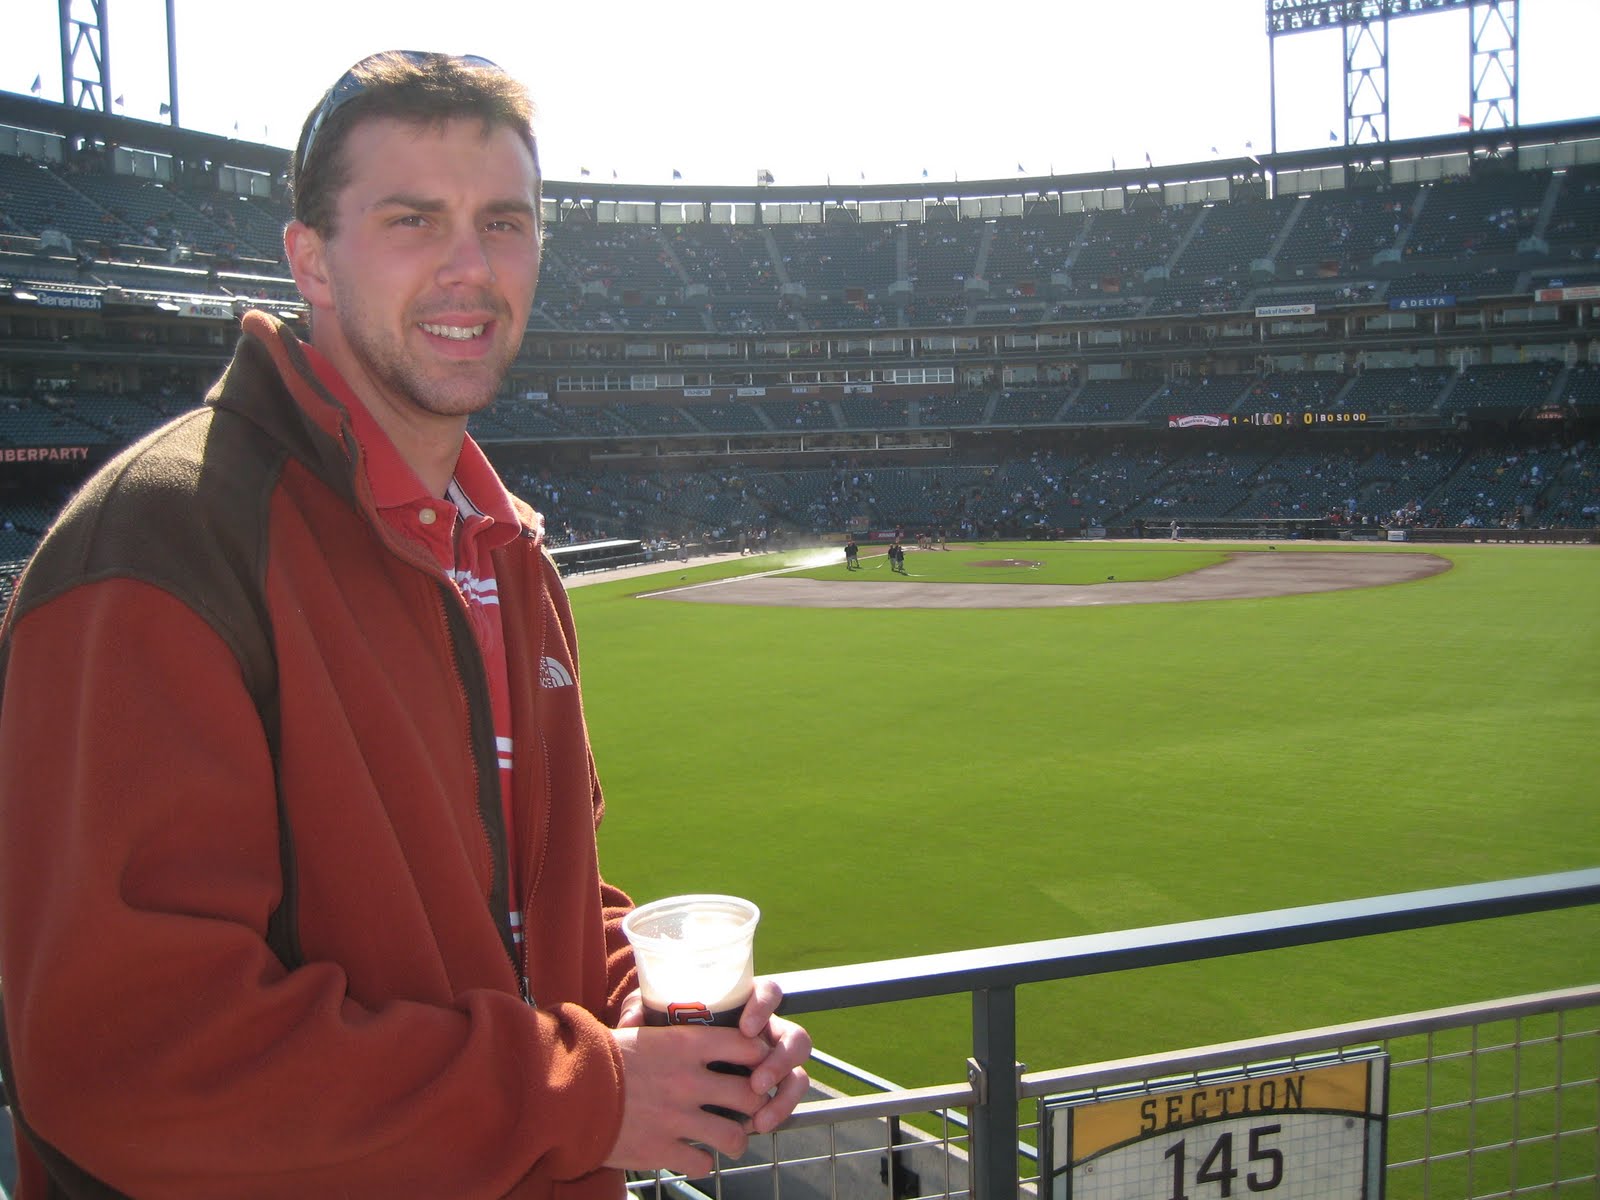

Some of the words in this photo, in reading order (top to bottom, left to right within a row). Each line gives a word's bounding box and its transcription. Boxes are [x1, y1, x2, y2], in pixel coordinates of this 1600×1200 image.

[37, 292, 101, 310] Genentech
[1410, 298, 1445, 308] DELTA
[1303, 412, 1312, 424] 0
[1140, 1075, 1305, 1133] SECTION
[1164, 1123, 1284, 1200] 145
